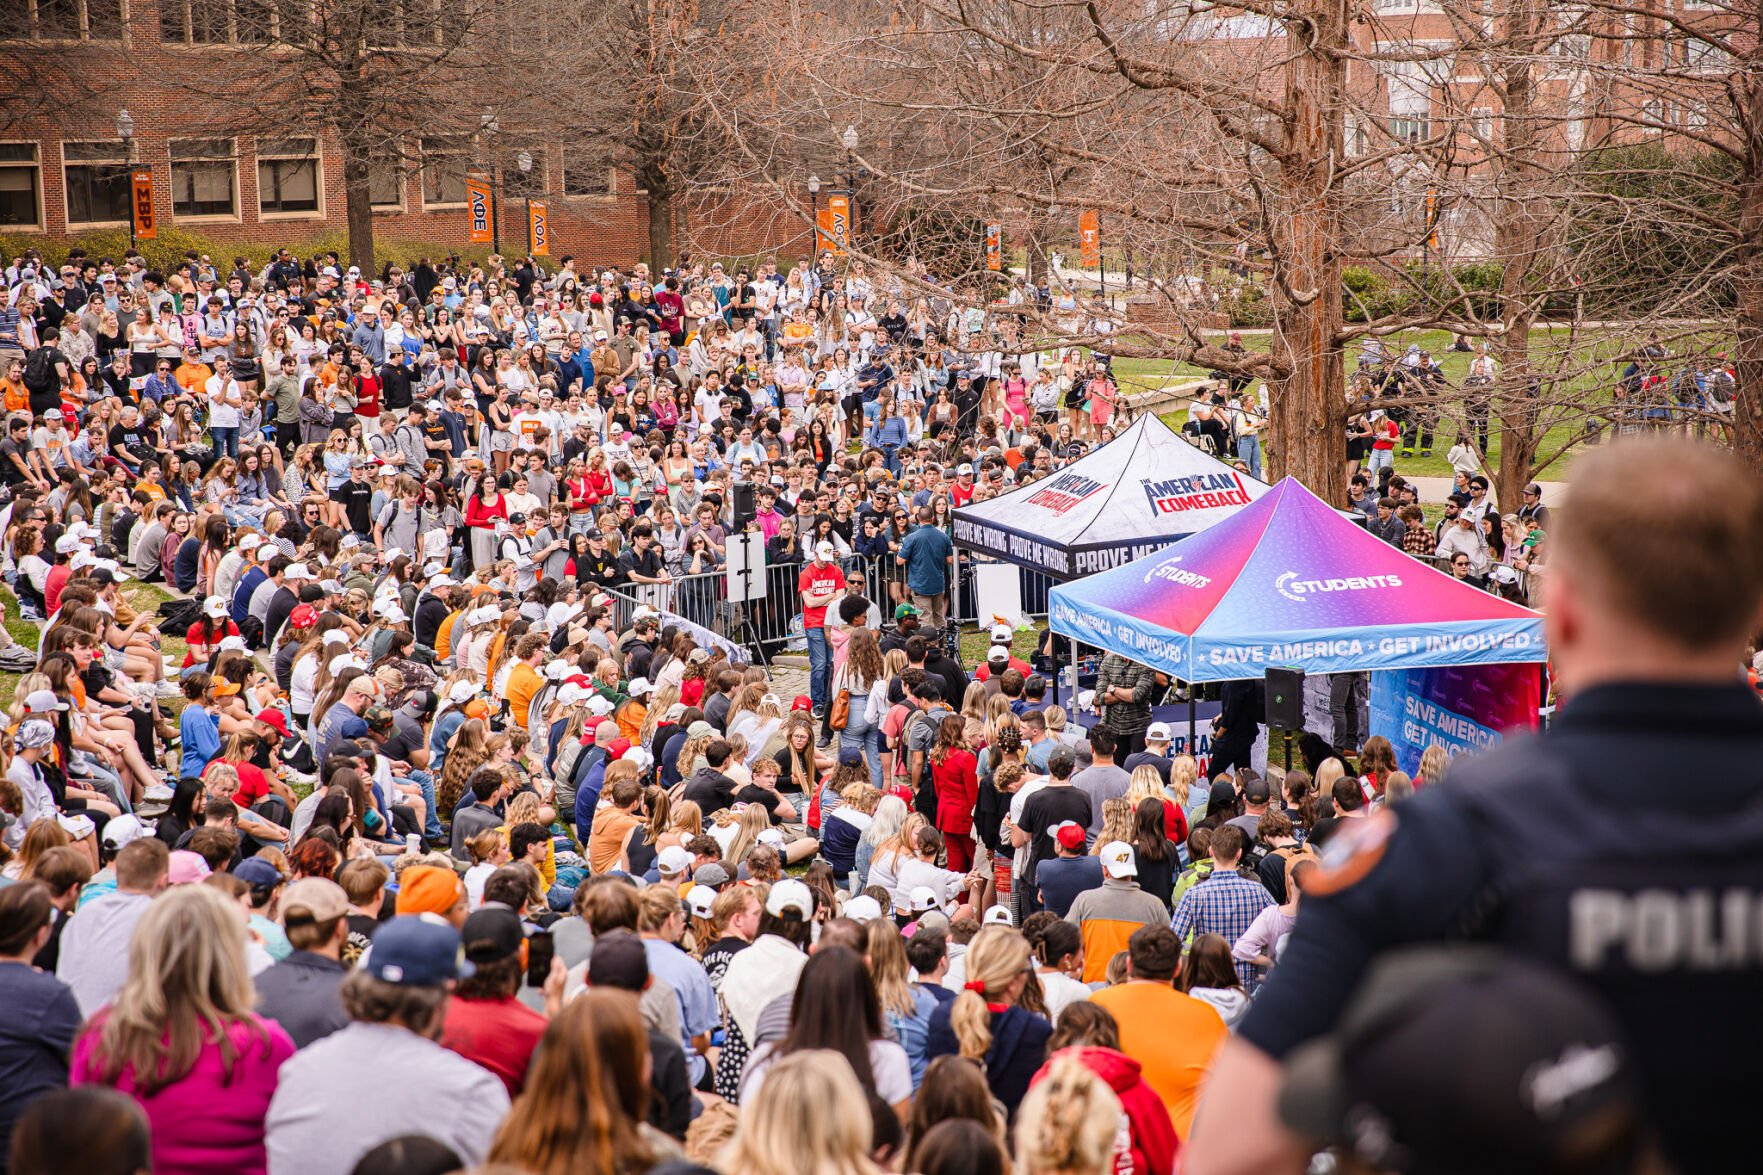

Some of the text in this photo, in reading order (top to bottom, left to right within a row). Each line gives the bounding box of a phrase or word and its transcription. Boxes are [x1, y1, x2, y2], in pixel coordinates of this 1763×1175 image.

[1157, 472, 1252, 513] COMEBACK
[953, 519, 1069, 574] PROVE ME WRONG PROVE ME WRONG
[1075, 547, 1129, 574] PROVE
[1156, 565, 1211, 589] STUDENTS
[1290, 575, 1403, 594] STUDENTS
[1055, 604, 1181, 663] SAVE AMERICA GET INVOLVED
[1210, 632, 1530, 666] SAVE AMERICA GET INVOLVED
[1404, 720, 1427, 747] GET
[1405, 696, 1495, 749] SAVE AMERICA
[1115, 852, 1130, 863] 47
[1569, 887, 1763, 972] POLI
